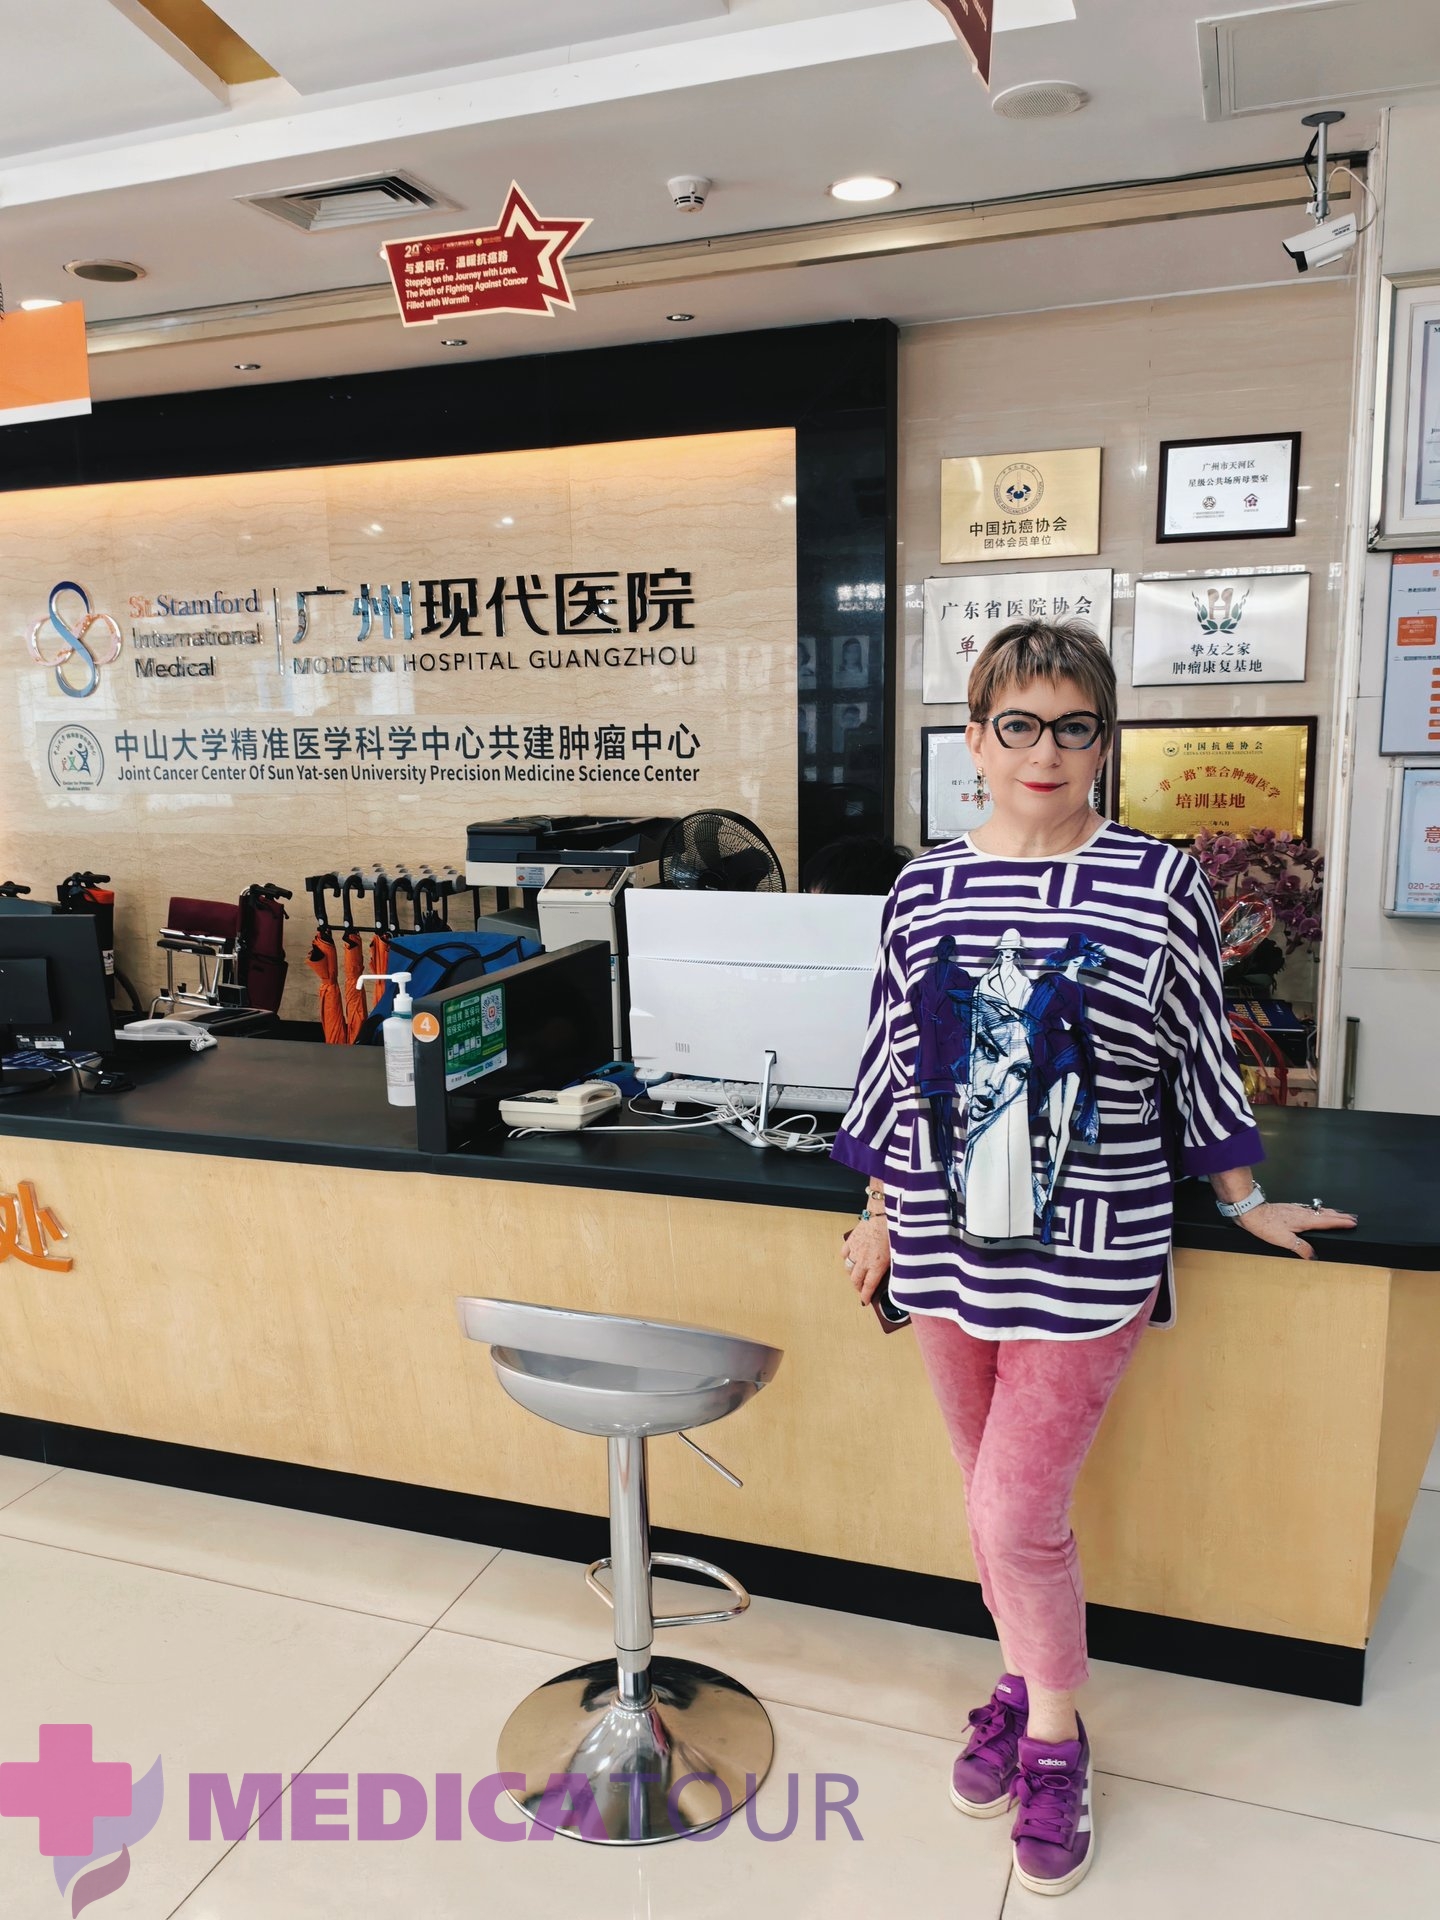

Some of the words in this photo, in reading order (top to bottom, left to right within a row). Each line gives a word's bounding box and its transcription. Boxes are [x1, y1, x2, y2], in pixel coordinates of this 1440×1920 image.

[432, 276, 441, 284] on
[443, 273, 453, 282] the
[455, 270, 482, 282] Journey
[483, 268, 498, 278] with
[406, 289, 418, 299] The
[420, 287, 435, 297] Path
[437, 286, 445, 295] of
[445, 282, 474, 295] Fighting
[475, 279, 501, 291] Against
[503, 276, 528, 287] Cancer
[406, 301, 425, 310] Filled
[426, 298, 440, 308] with
[441, 295, 470, 306] Warmth
[1202, 460, 1255, 471] 广州市天河区
[1188, 474, 1269, 488] 星级公共场所母婴室
[969, 516, 1067, 537] 中国抗癌协会
[984, 535, 1052, 550] 团体会员单位
[293, 567, 695, 643] 广州现代医院
[941, 595, 1092, 621] 广东省医院协会
[132, 623, 264, 648] International
[956, 634, 978, 662] 单
[1190, 642, 1251, 657] 挚友之家
[135, 655, 216, 678] Medical
[293, 655, 394, 674] MODERN
[403, 651, 520, 672] HOSPITAL
[529, 646, 695, 669] GUANGZHOU
[1172, 659, 1263, 675] 肿瘤康复基地
[114, 723, 701, 762] 中山大学精准医学科学中心共建肿瘤中心
[1183, 741, 1264, 751] 中国抗癌协会
[118, 765, 151, 781] Joint
[154, 766, 198, 781] Cancer
[201, 765, 246, 780] Center
[250, 764, 265, 780] Of
[268, 765, 294, 780] Sun
[297, 765, 348, 780] Yat-sen
[351, 764, 427, 785] University
[430, 764, 500, 781] Precision
[505, 764, 575, 781] Medicine
[579, 765, 640, 781] Science
[644, 765, 700, 781] Center
[1175, 793, 1246, 809] 培训基地
[420, 1016, 431, 1032] 4
[1038, 1758, 1067, 1766] adidas
